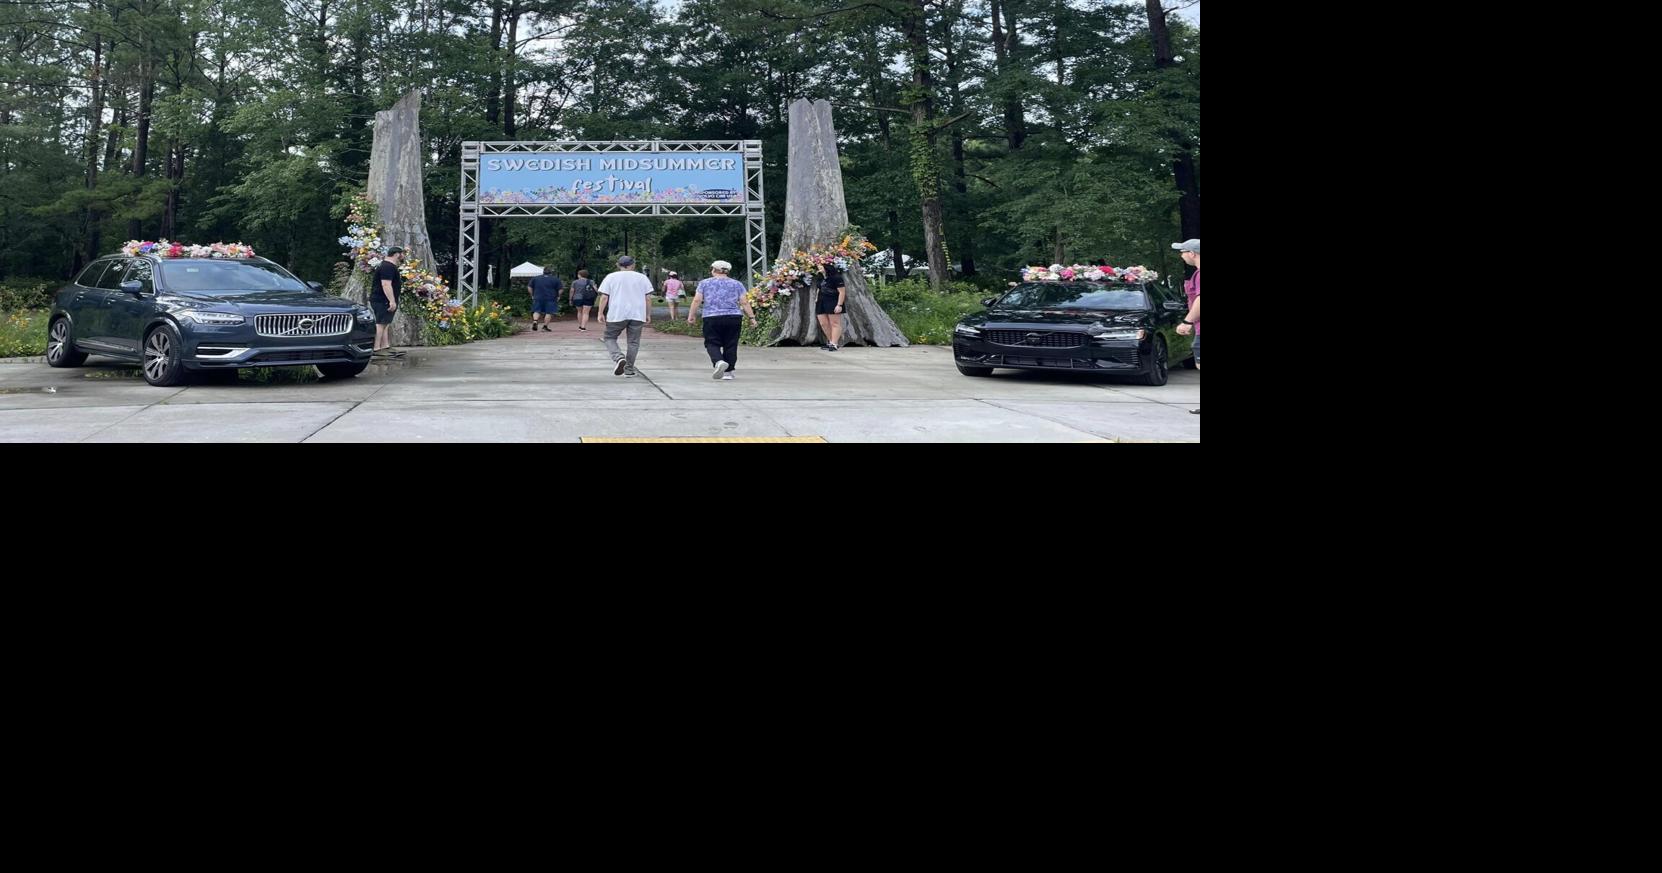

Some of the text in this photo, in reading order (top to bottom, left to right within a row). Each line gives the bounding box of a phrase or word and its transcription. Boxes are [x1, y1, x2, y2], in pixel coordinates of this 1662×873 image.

[487, 158, 737, 171] SWEDISH MIDSUMMER
[572, 173, 653, 195] festival
